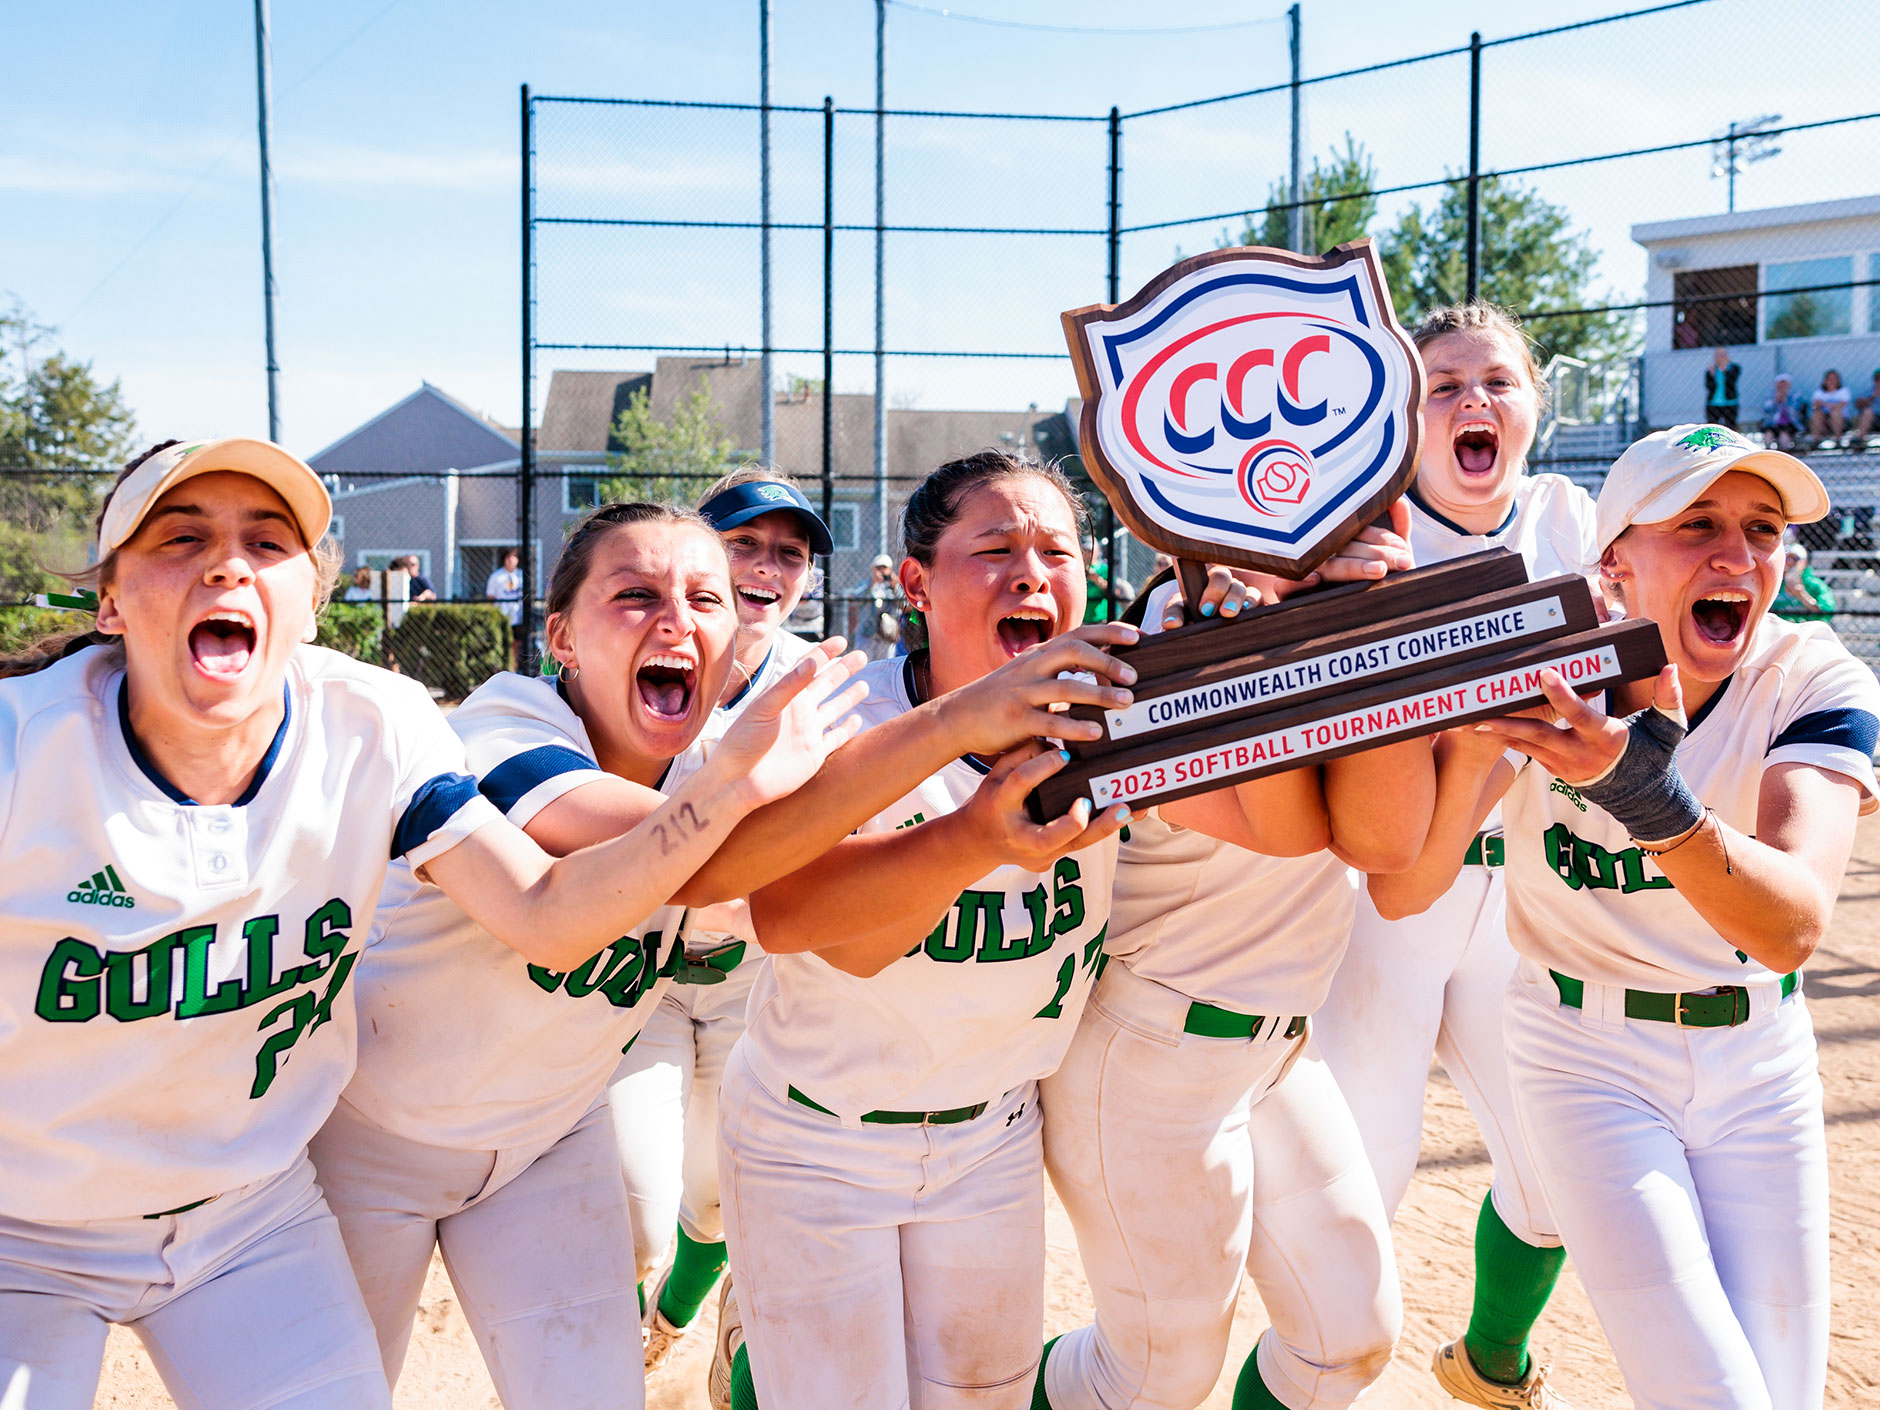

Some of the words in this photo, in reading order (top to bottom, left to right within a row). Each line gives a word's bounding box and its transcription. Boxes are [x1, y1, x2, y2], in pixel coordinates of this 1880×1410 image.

[1163, 334, 1331, 455] CCC
[1331, 406, 1347, 417] TM
[1148, 663, 1322, 724] COMMONWEALTH
[1328, 645, 1390, 679] COAST
[1397, 611, 1525, 661] CONFERENCE
[1110, 767, 1167, 799] 2023
[1174, 735, 1295, 782] SOFTBALL
[1301, 688, 1468, 750] TOURNAMENT
[1475, 654, 1602, 704] CHAMION
[651, 800, 711, 856] 212
[1550, 781, 1588, 813] adidas
[66, 888, 136, 909] adidas
[1543, 822, 1676, 894] GUL
[903, 856, 1086, 963] ULLS
[34, 896, 353, 1023] GULLS
